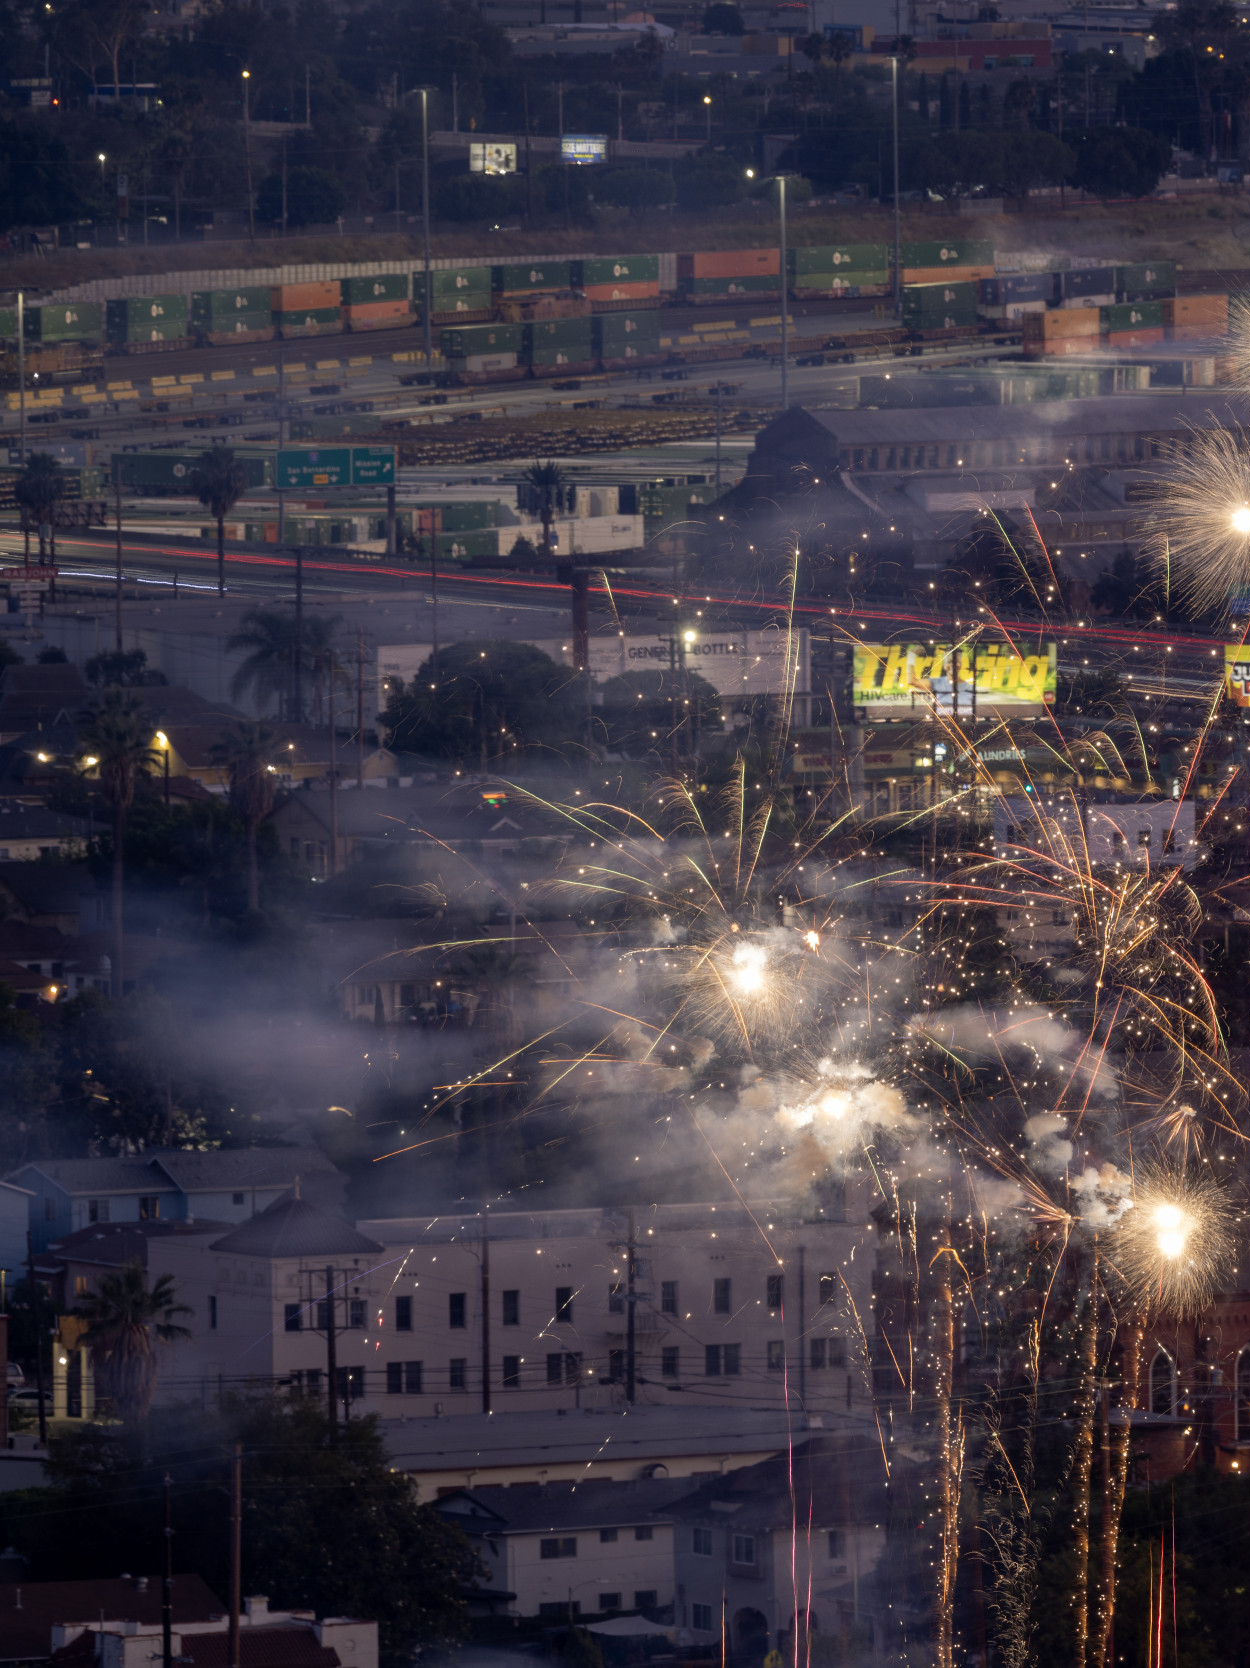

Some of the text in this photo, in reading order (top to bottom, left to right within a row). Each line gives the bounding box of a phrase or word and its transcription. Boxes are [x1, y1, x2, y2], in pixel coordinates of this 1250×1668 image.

[287, 467, 301, 475] San
[4, 569, 56, 578] RABJOHN
[629, 643, 739, 659] GENER BOTTLE
